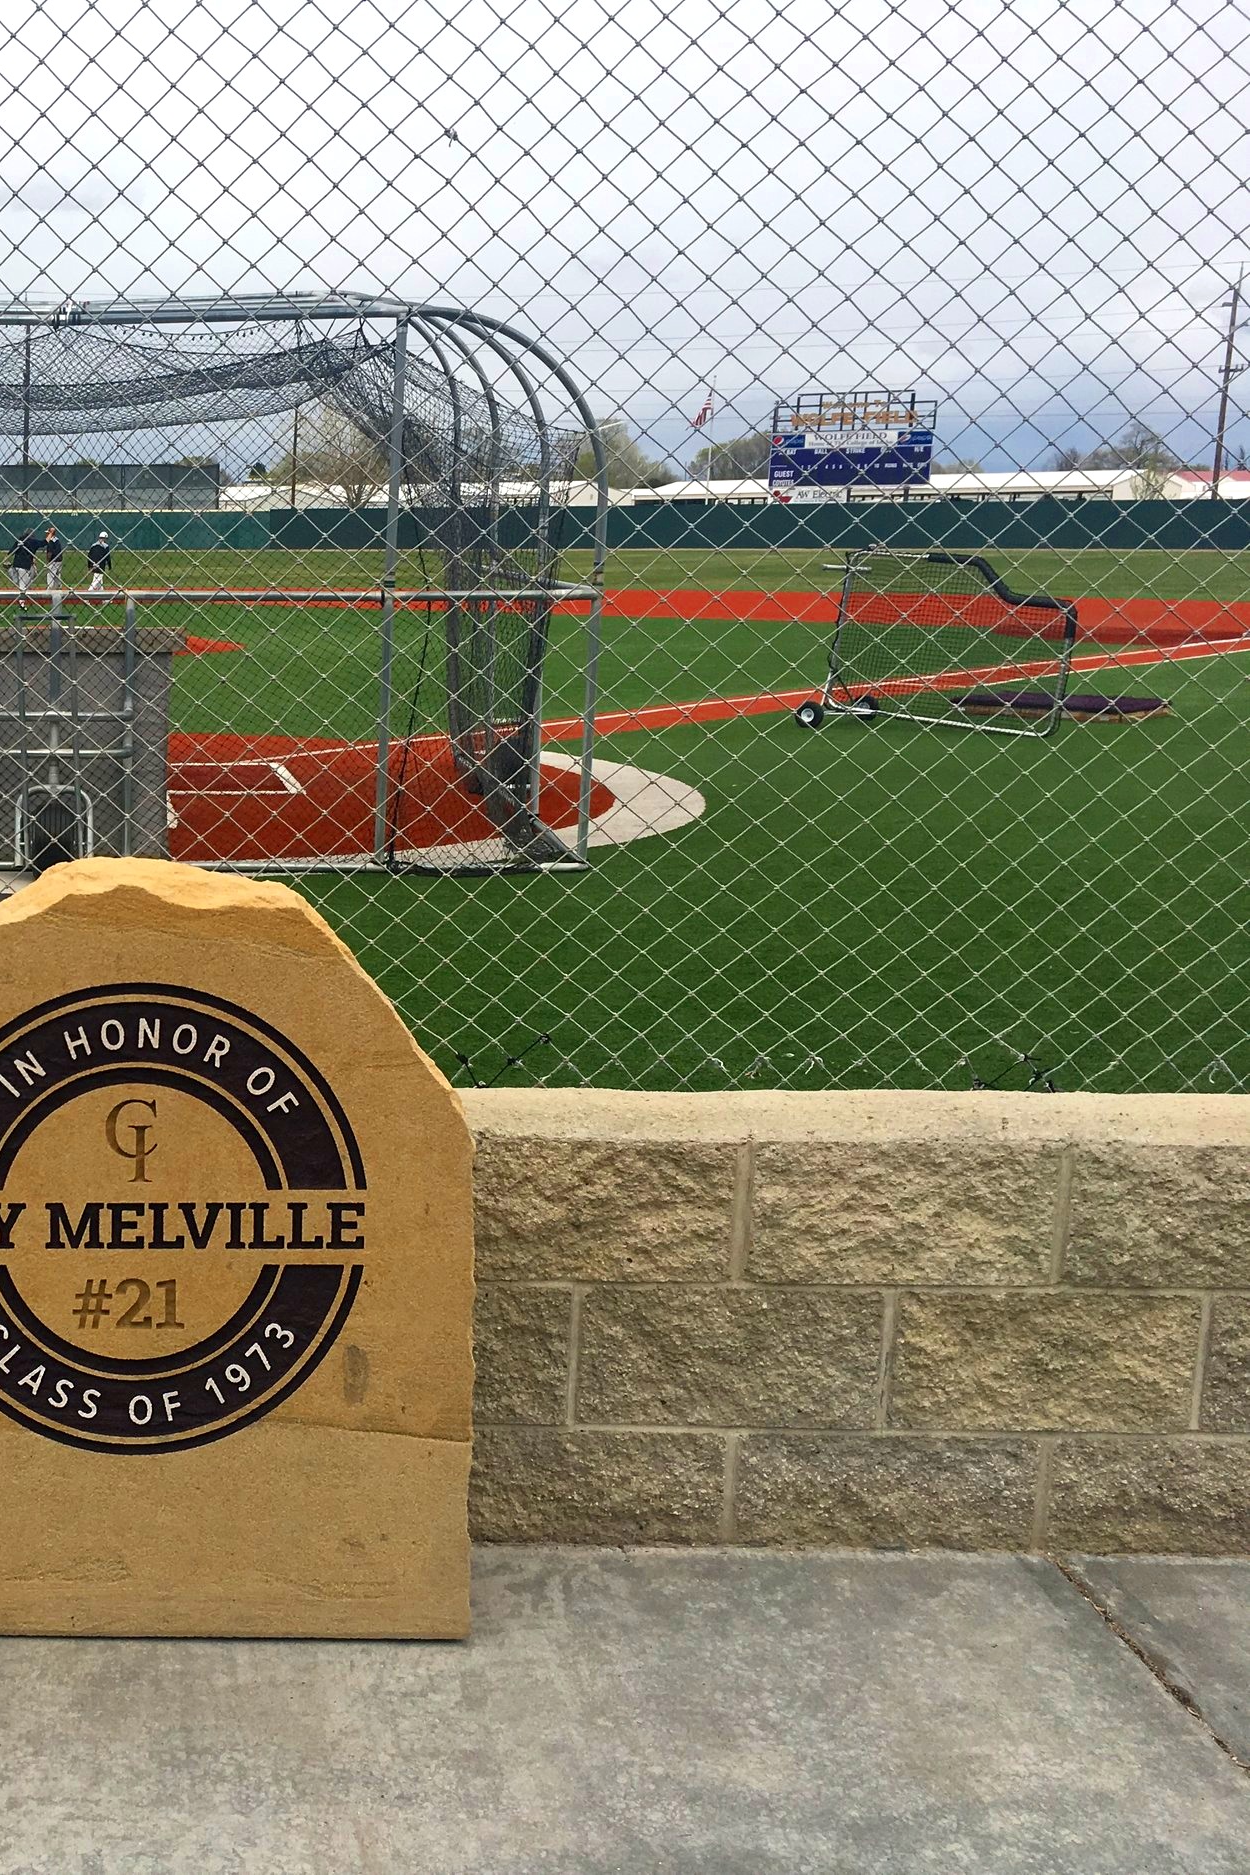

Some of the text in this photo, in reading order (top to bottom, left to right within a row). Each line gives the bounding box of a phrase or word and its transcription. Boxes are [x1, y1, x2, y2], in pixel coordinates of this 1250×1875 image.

[790, 410, 919, 427] WOLFE FIELD
[813, 431, 888, 441] WOLFE FIELD
[846, 446, 866, 454] STRIKE
[773, 470, 795, 478] GUEST
[772, 479, 795, 487] COYOTES
[63, 1017, 232, 1068] HONOR
[246, 1066, 300, 1115] OF
[44, 1202, 366, 1250] MELVILLE
[71, 1278, 186, 1330] #21
[128, 1390, 182, 1426] OF
[204, 1322, 296, 1405] 1973
